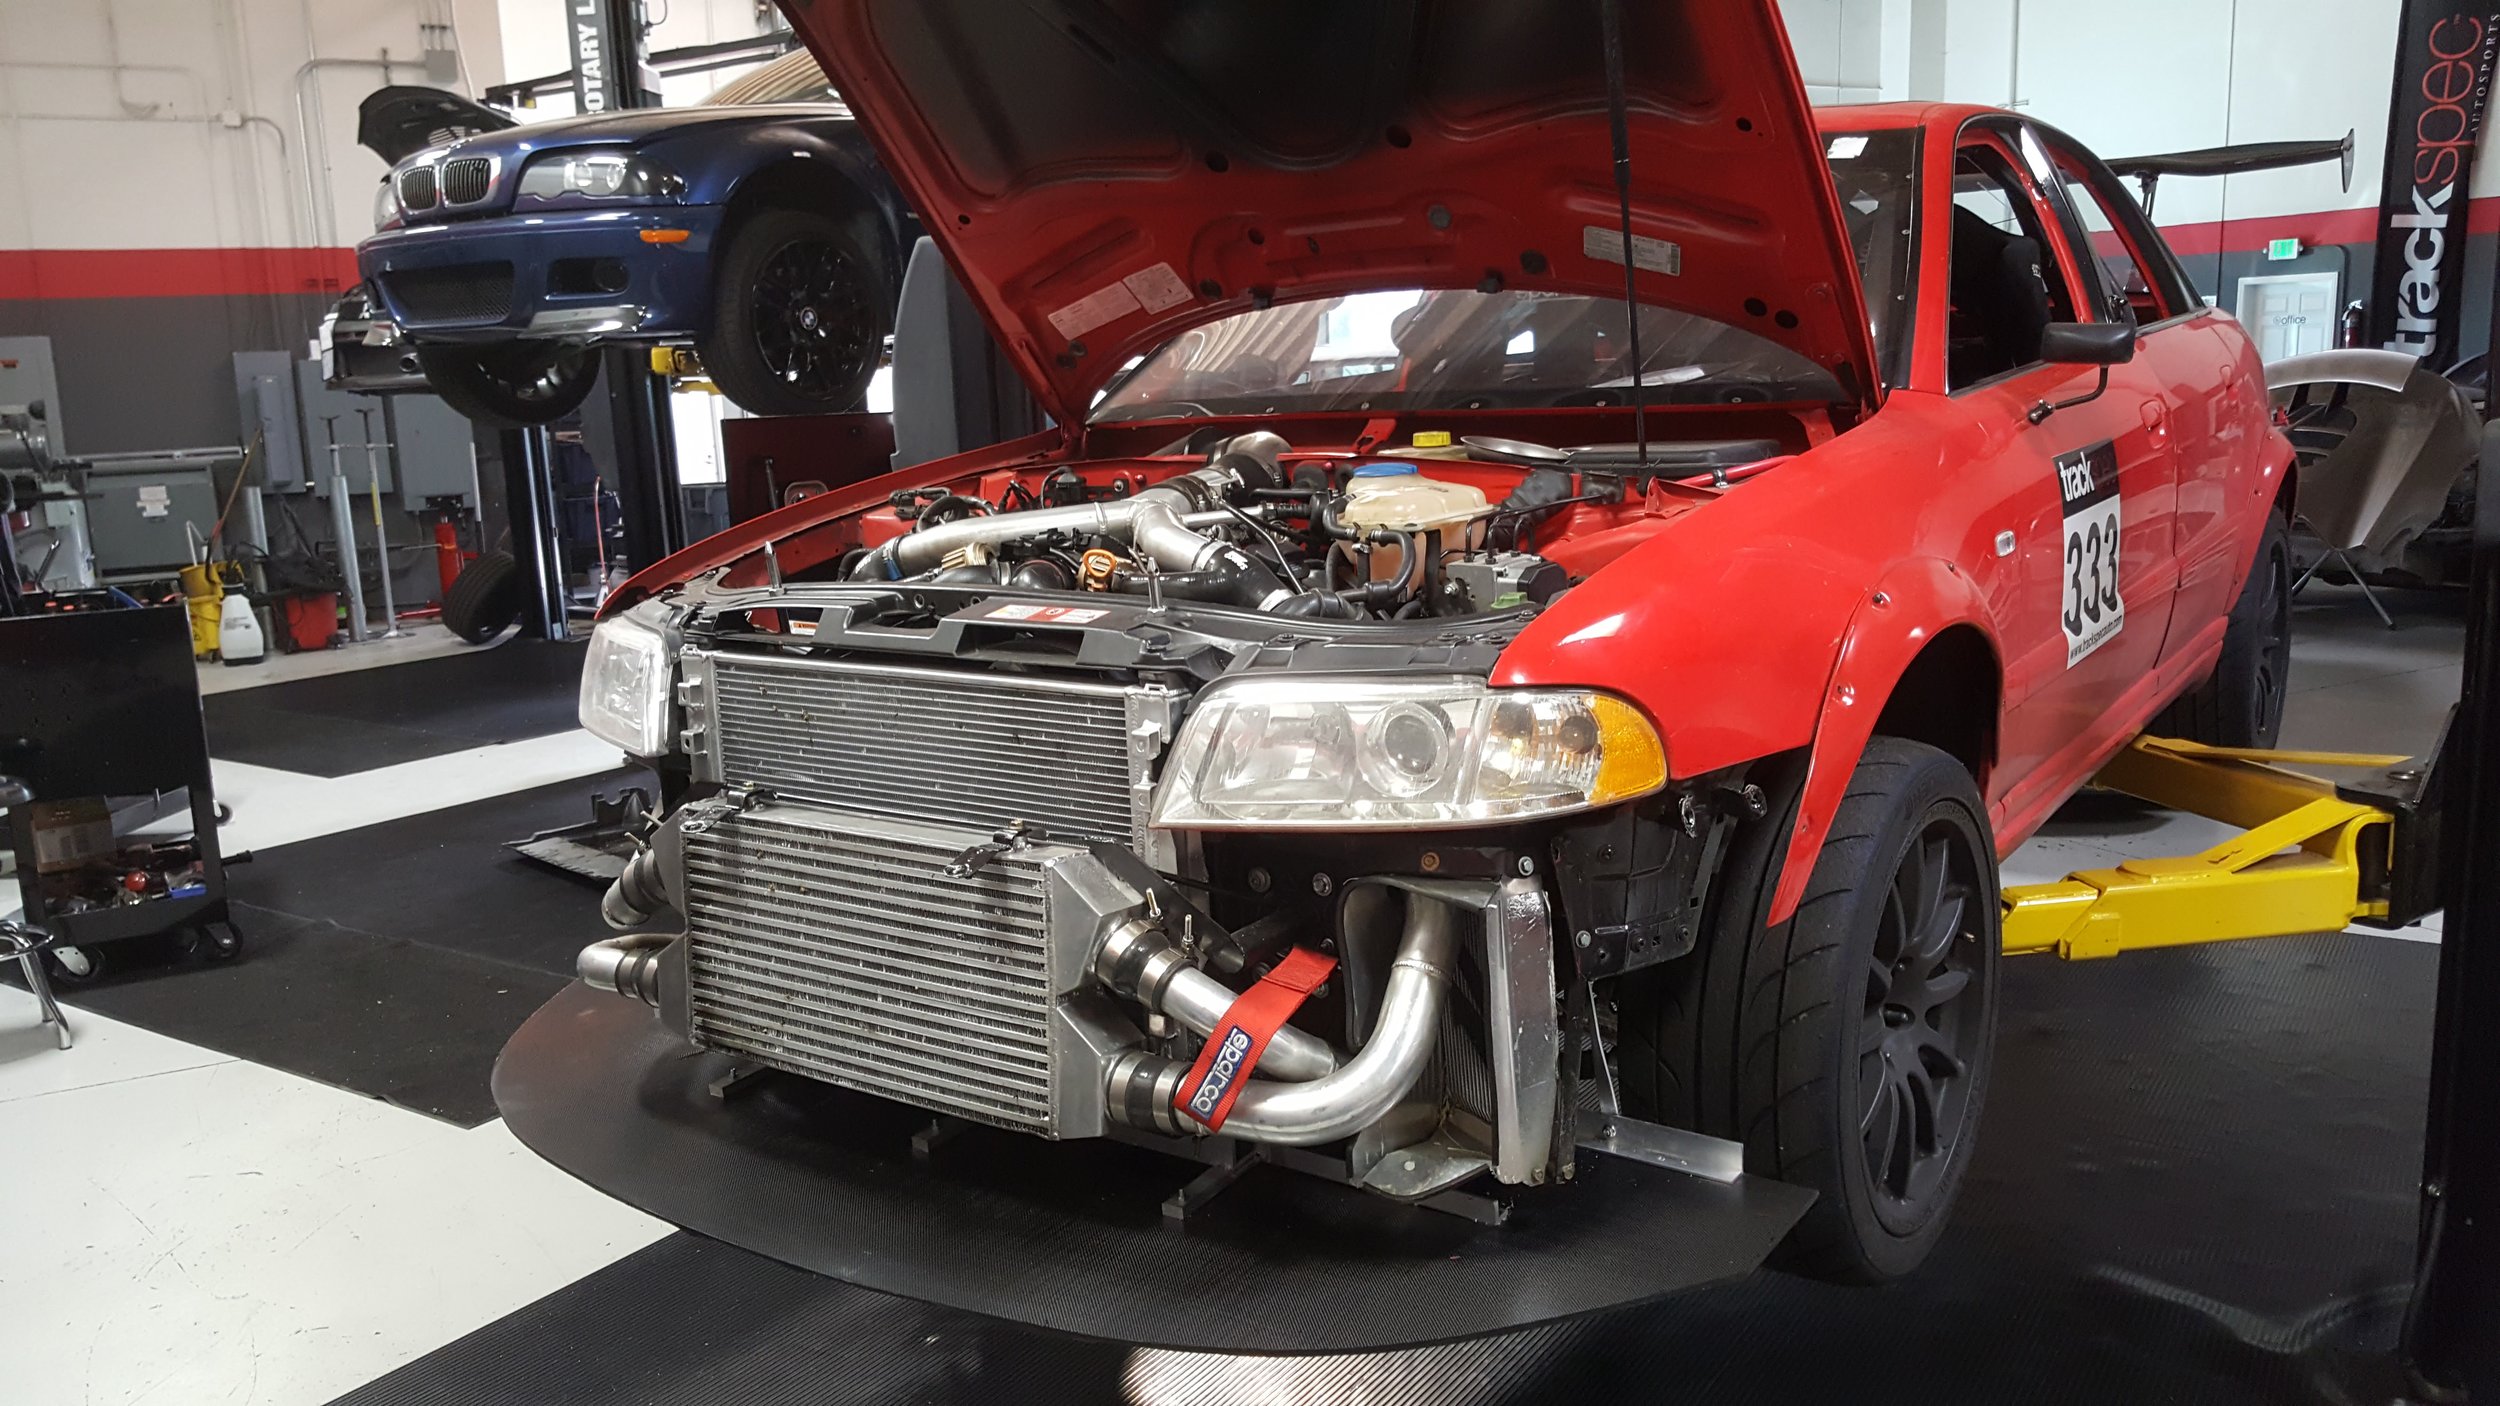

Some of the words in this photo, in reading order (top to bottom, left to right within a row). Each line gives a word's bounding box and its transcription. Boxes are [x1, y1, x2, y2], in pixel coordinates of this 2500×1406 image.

[577, 23, 605, 114] OTARY
[2281, 315, 2307, 325] office
[2064, 513, 2118, 637] 333
[1190, 1027, 1249, 1113] sparco
